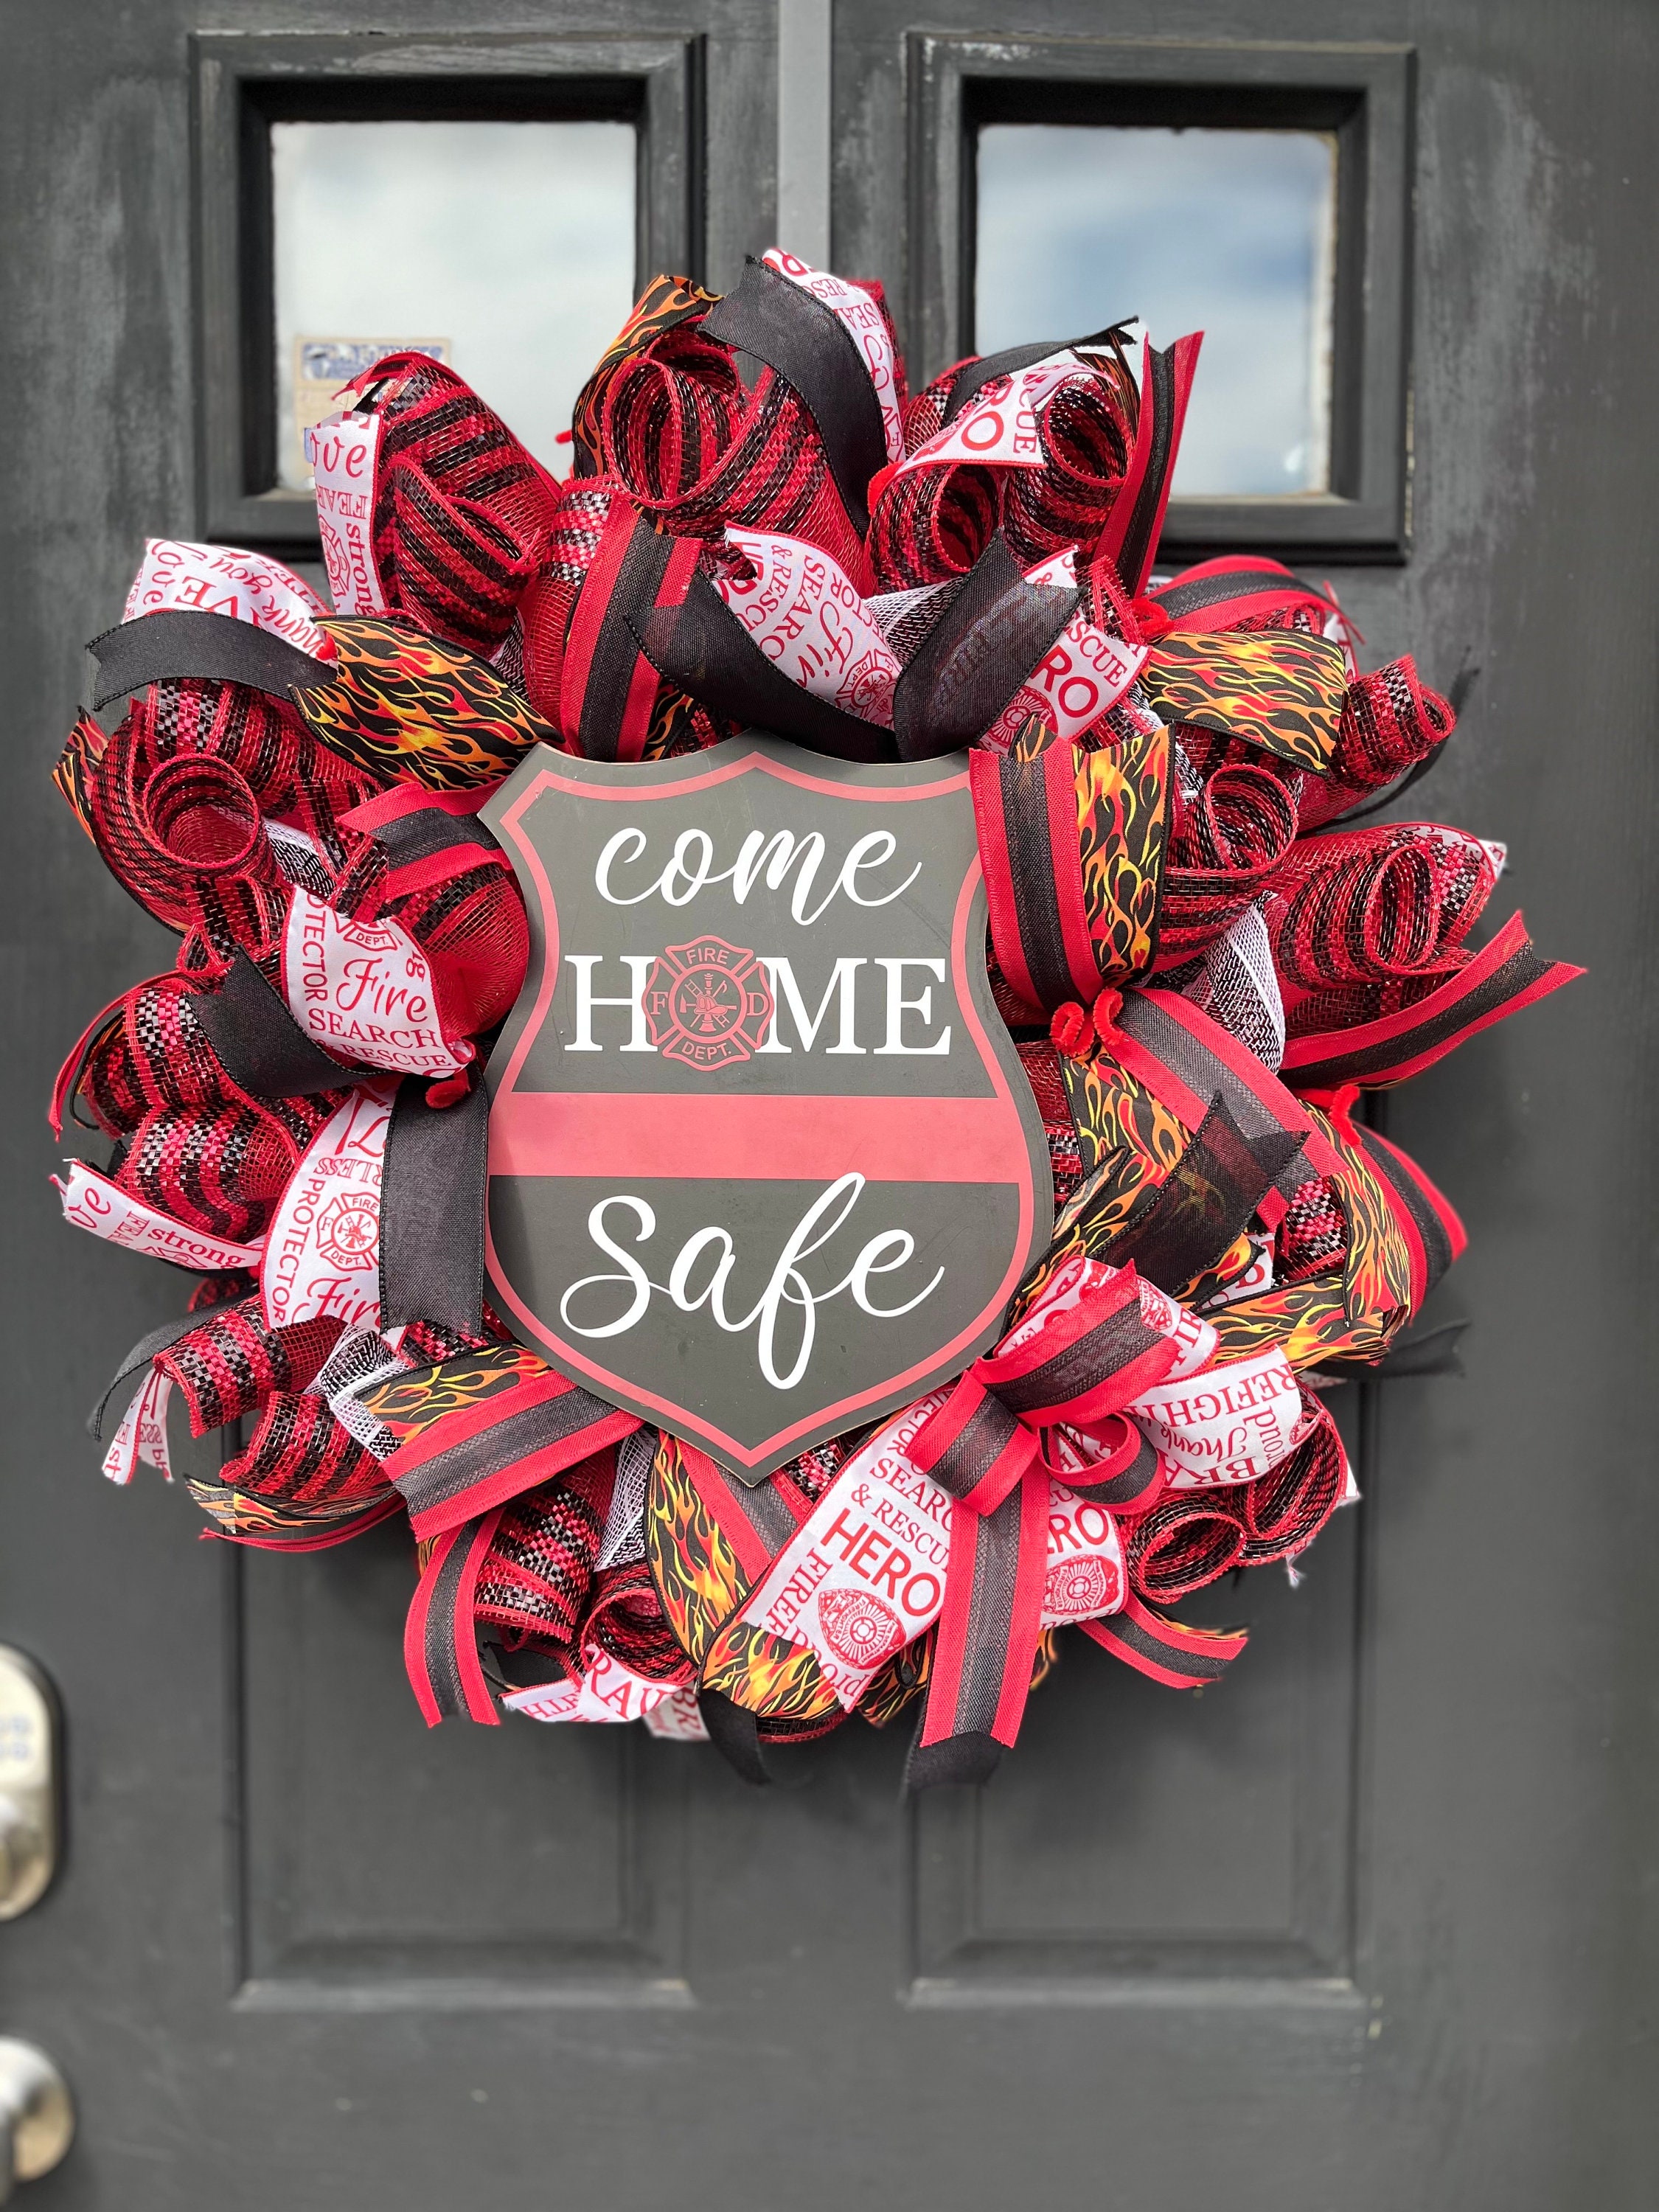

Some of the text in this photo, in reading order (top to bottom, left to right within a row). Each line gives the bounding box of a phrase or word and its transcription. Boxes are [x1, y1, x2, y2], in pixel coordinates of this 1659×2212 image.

[594, 827, 924, 927] come
[686, 947, 730, 965] FIRE
[336, 957, 428, 1023] Fire
[308, 1007, 443, 1049] SEARCH
[682, 1041, 731, 1060] DEPT.
[272, 1178, 324, 1323] PROTECTOR
[821, 1508, 940, 1618] HERO
